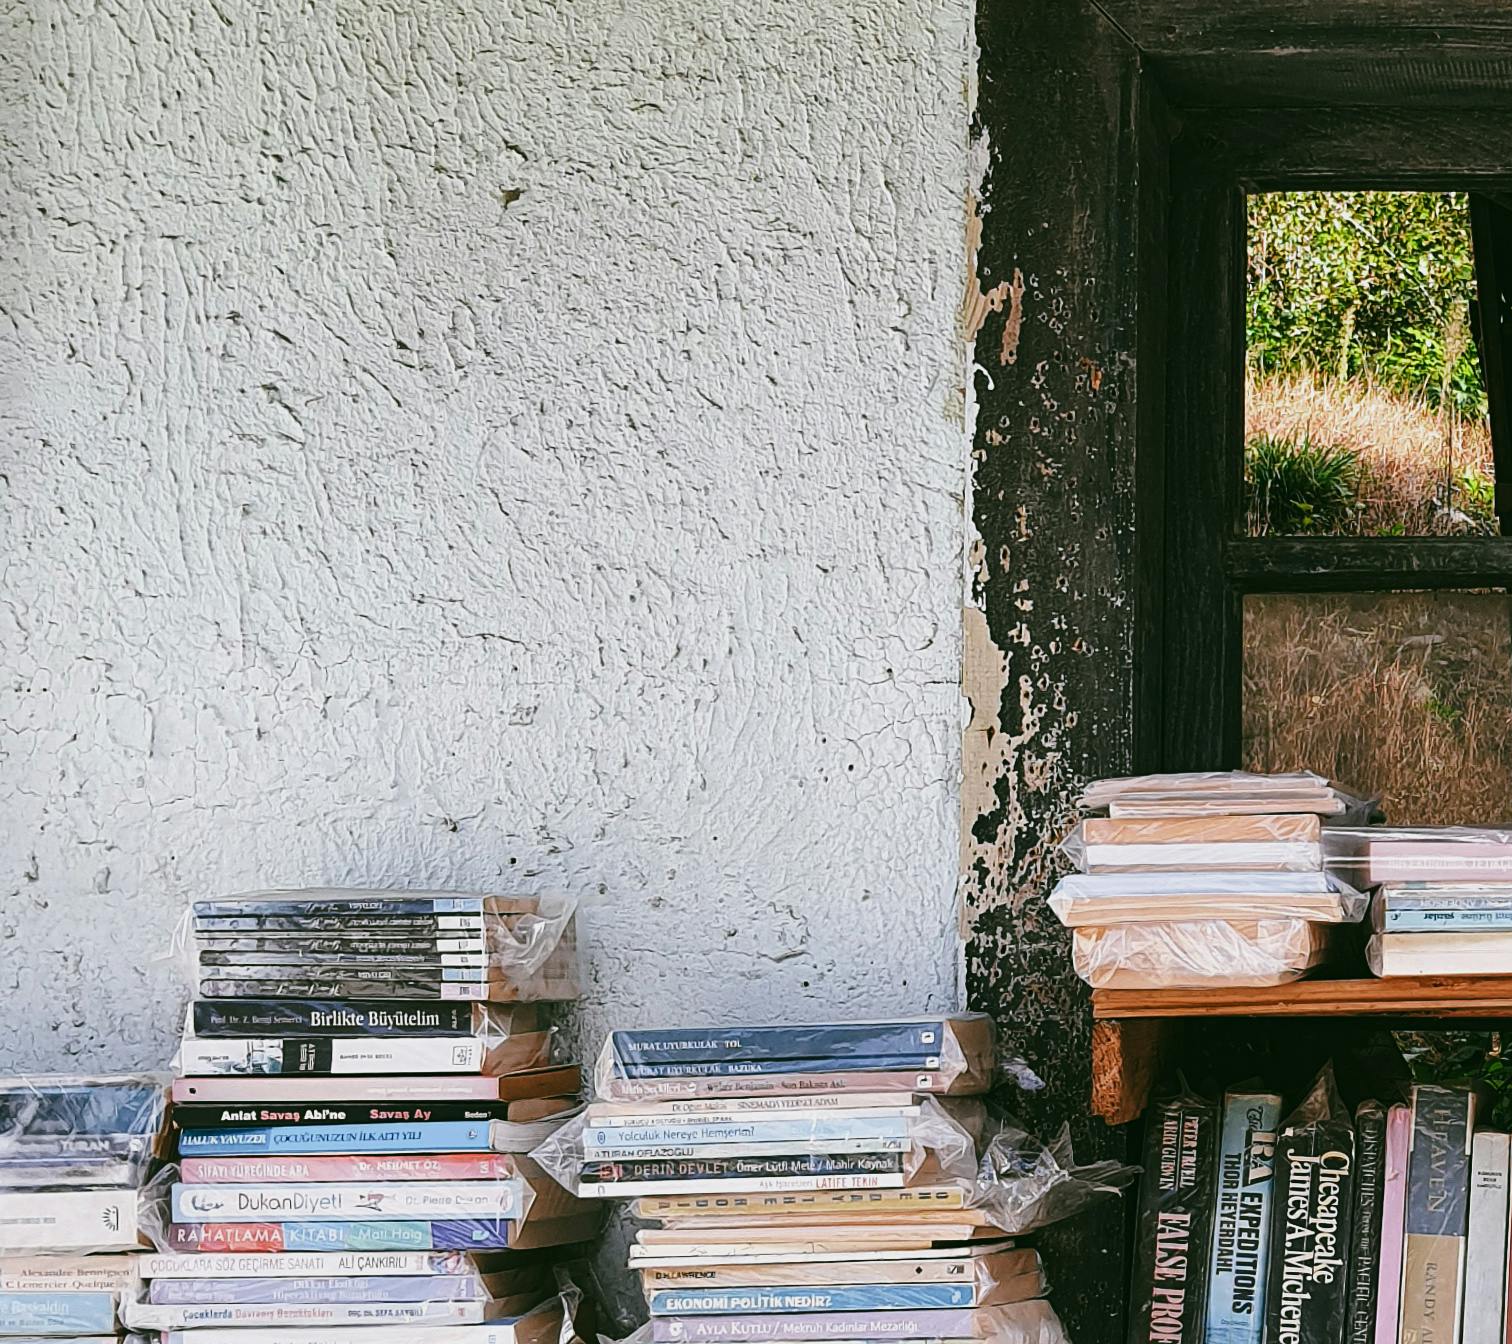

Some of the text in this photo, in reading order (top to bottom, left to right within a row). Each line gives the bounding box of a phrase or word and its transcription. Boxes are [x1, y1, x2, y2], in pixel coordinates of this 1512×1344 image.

[310, 1011, 439, 1030] Birlikte Büyütelim
[221, 1110, 300, 1123] Anlat Savaş
[370, 1109, 431, 1121] Savaş Ay
[182, 1135, 266, 1145] HALUK YAVUZER
[274, 1131, 357, 1144] ÇOCUĞUNUZUN
[359, 1131, 380, 1141] İLK
[618, 1129, 660, 1141] Yolculuk
[1181, 1116, 1200, 1188] PETER TRUELL
[1243, 1131, 1276, 1187] RA
[678, 1161, 728, 1175] DEVLET
[826, 1157, 855, 1170] Mahir
[1159, 1147, 1172, 1192] GURWIN
[1428, 1108, 1451, 1214] HEAVEN
[1287, 1147, 1312, 1222] James
[1216, 1153, 1241, 1276] THOR HEYERDAHL
[1313, 1150, 1350, 1284] Chesapeake
[177, 1222, 283, 1243] RAHATLAMA
[1286, 1225, 1315, 1250] A.
[1153, 1211, 1192, 1282] FALSE
[1232, 1192, 1263, 1315] EXPEDITIONS
[238, 1257, 285, 1271] GEÇİRME
[288, 1258, 324, 1270] SANATI
[339, 1255, 354, 1269] ALİ
[20, 1269, 74, 1277] Alexandre
[16, 1280, 69, 1289] Lemercier
[1426, 1262, 1439, 1321] RANDY
[666, 1295, 729, 1310] EKONOMİ
[731, 1295, 783, 1309] POLİTİK
[697, 1321, 918, 1335] AYLA KUTLU Mekruh Kadınlar Mezarlığı
